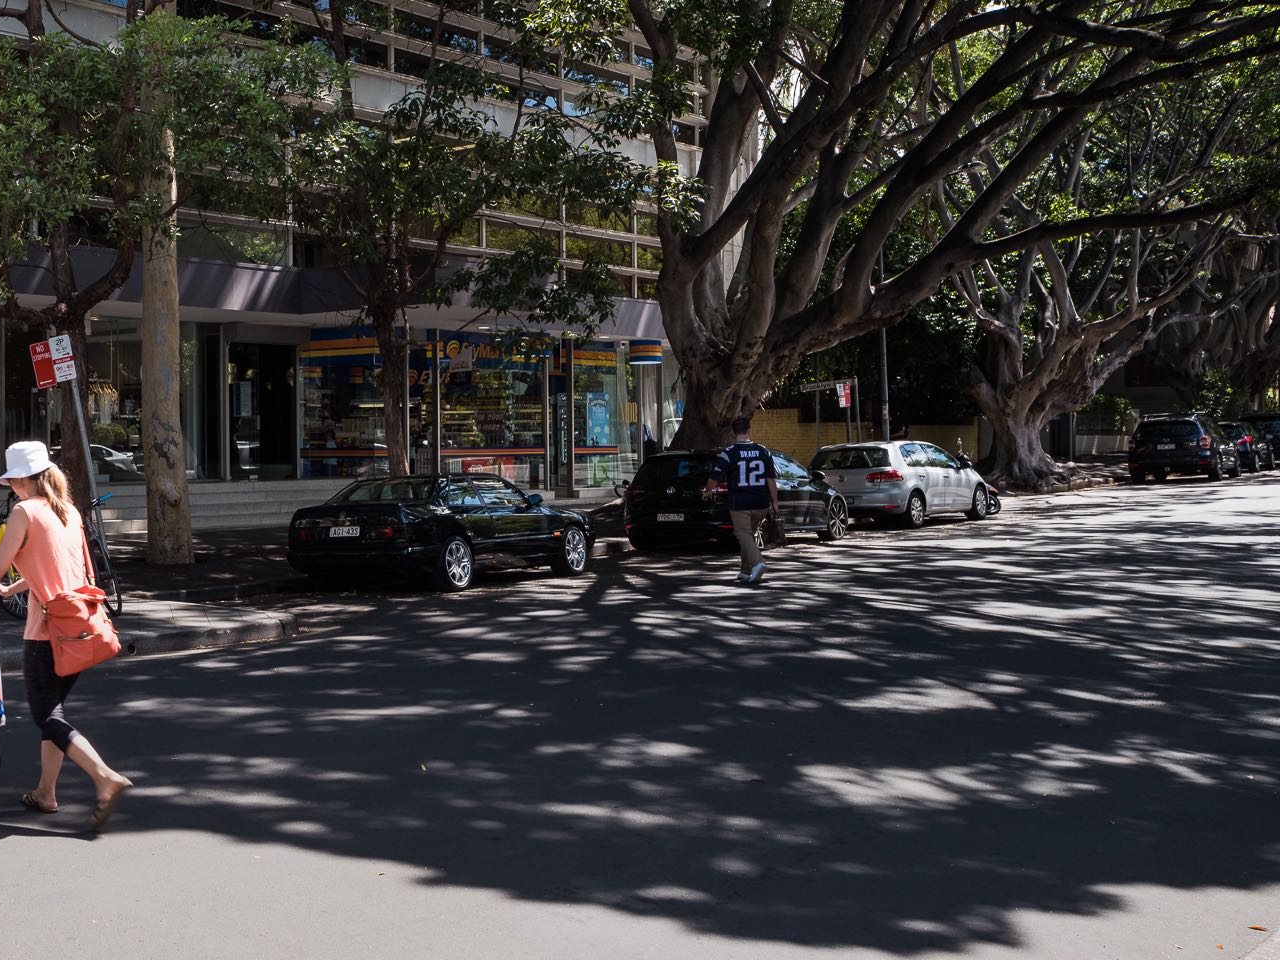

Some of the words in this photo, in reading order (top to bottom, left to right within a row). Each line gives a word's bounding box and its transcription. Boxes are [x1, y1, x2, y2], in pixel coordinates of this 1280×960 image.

[36, 344, 44, 353] NO
[32, 353, 51, 361] STOPPING
[740, 450, 759, 458] BRADY
[737, 460, 765, 487] 12
